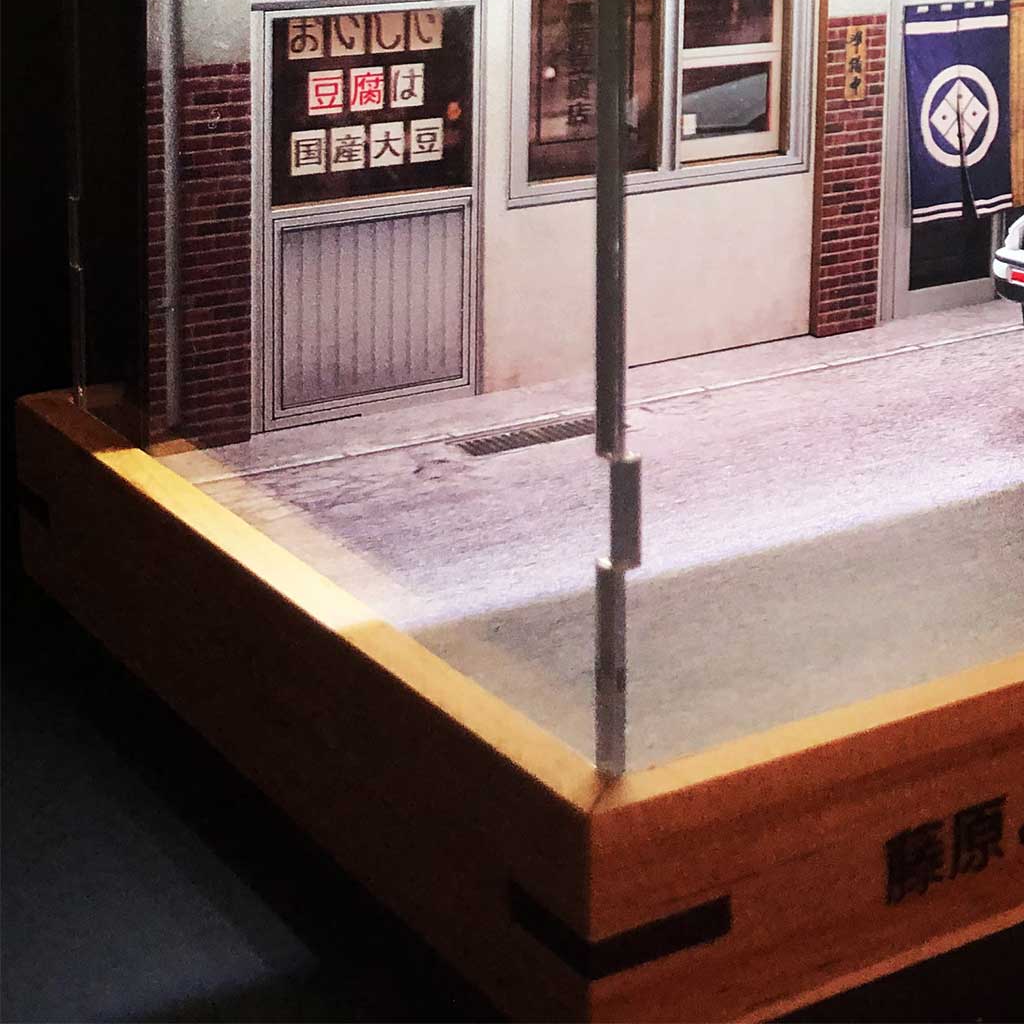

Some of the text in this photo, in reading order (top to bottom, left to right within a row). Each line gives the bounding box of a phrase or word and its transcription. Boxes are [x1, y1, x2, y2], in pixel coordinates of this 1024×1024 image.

[290, 11, 437, 54] おいしい
[310, 67, 423, 111] 豆腐は
[295, 126, 441, 168] 国産大豆
